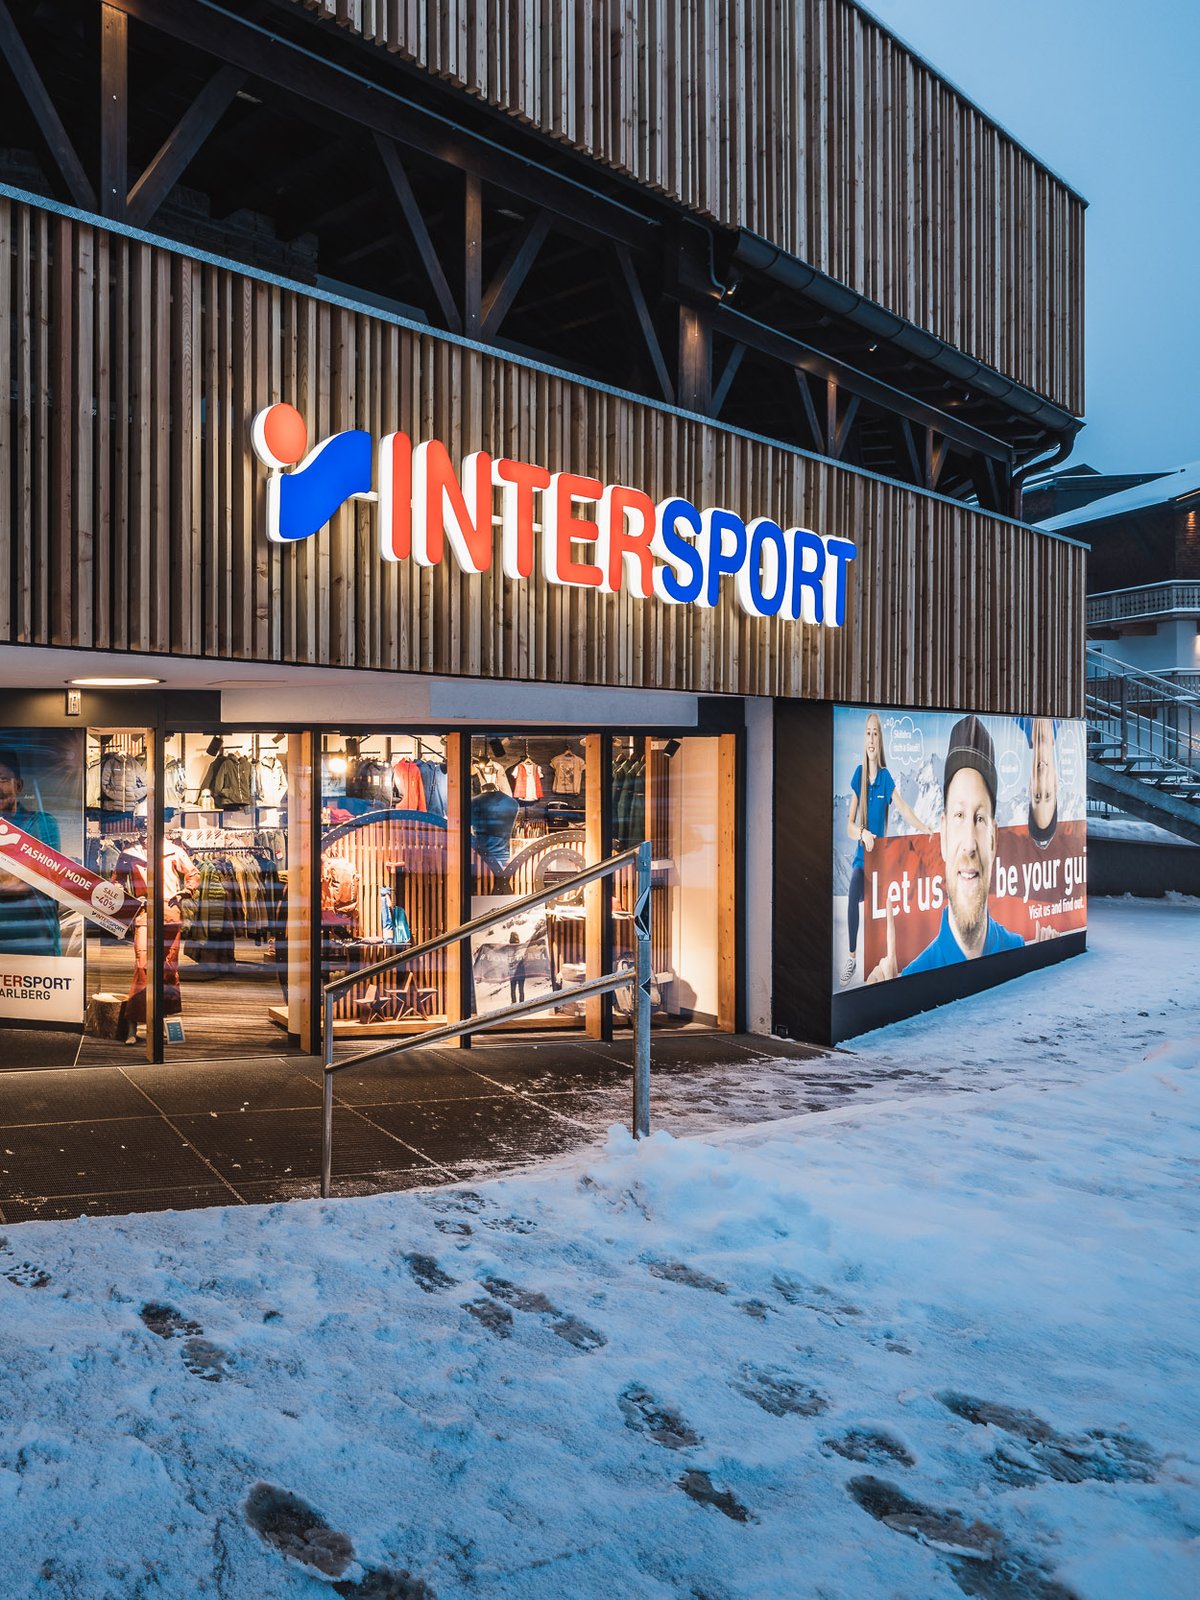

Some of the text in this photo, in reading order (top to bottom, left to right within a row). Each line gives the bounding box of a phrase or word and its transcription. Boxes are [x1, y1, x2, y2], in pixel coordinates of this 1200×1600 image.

[379, 431, 857, 628] INTERSPORT
[20, 843, 61, 873] FASHION
[65, 869, 93, 891] MODE
[872, 846, 1087, 919] Let us be your gui
[95, 895, 116, 911] -40%
[103, 887, 119, 899] SALE
[1028, 896, 1085, 919] Visit us and find out.
